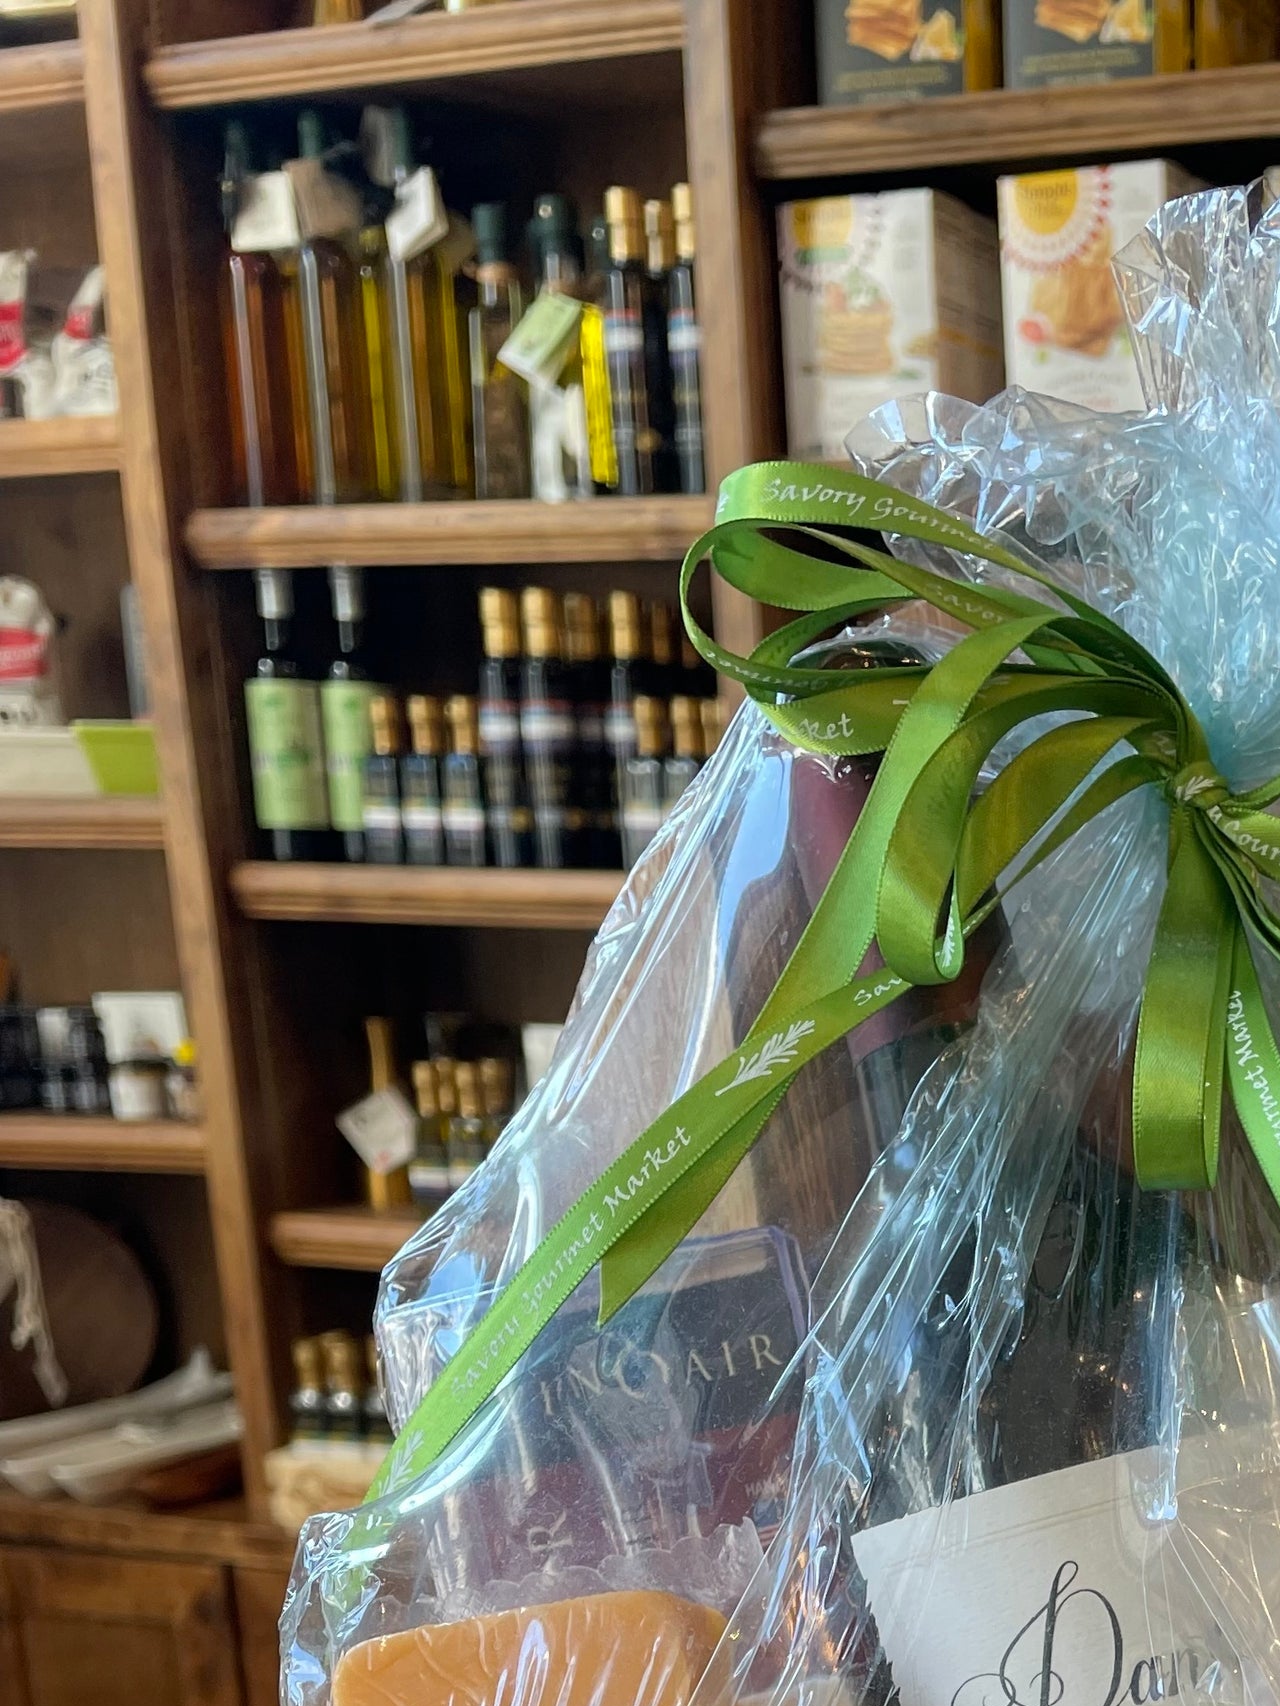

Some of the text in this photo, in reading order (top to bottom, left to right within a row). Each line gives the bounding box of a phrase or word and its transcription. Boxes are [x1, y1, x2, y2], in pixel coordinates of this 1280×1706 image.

[761, 477, 866, 517] Savory
[450, 1125, 692, 1403] Savory Gourmet Market
